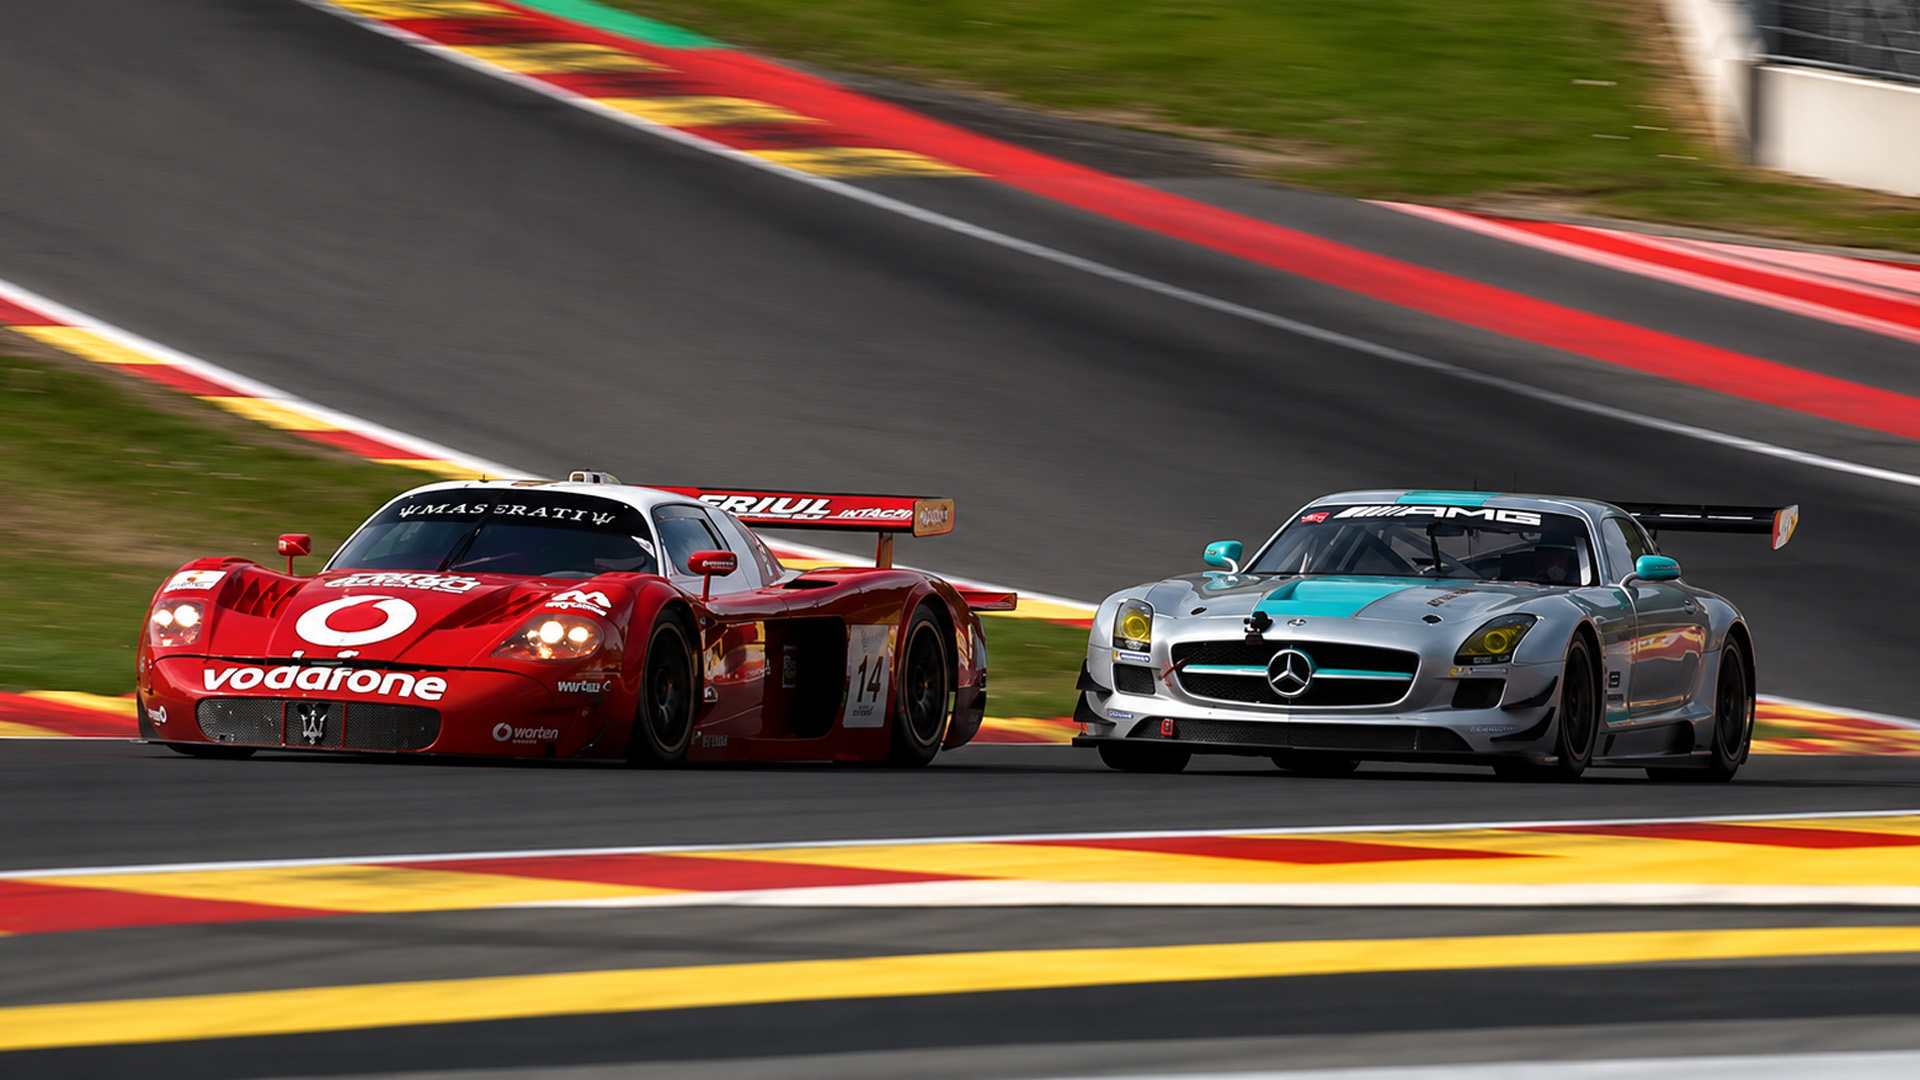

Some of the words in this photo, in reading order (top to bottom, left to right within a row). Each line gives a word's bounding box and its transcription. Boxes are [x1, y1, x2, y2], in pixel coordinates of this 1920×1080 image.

[418, 503, 588, 521] MASERATI
[1393, 506, 1541, 526] AMG
[203, 650, 447, 700] vodafone
[857, 655, 884, 703] 14
[514, 726, 559, 739] worten
